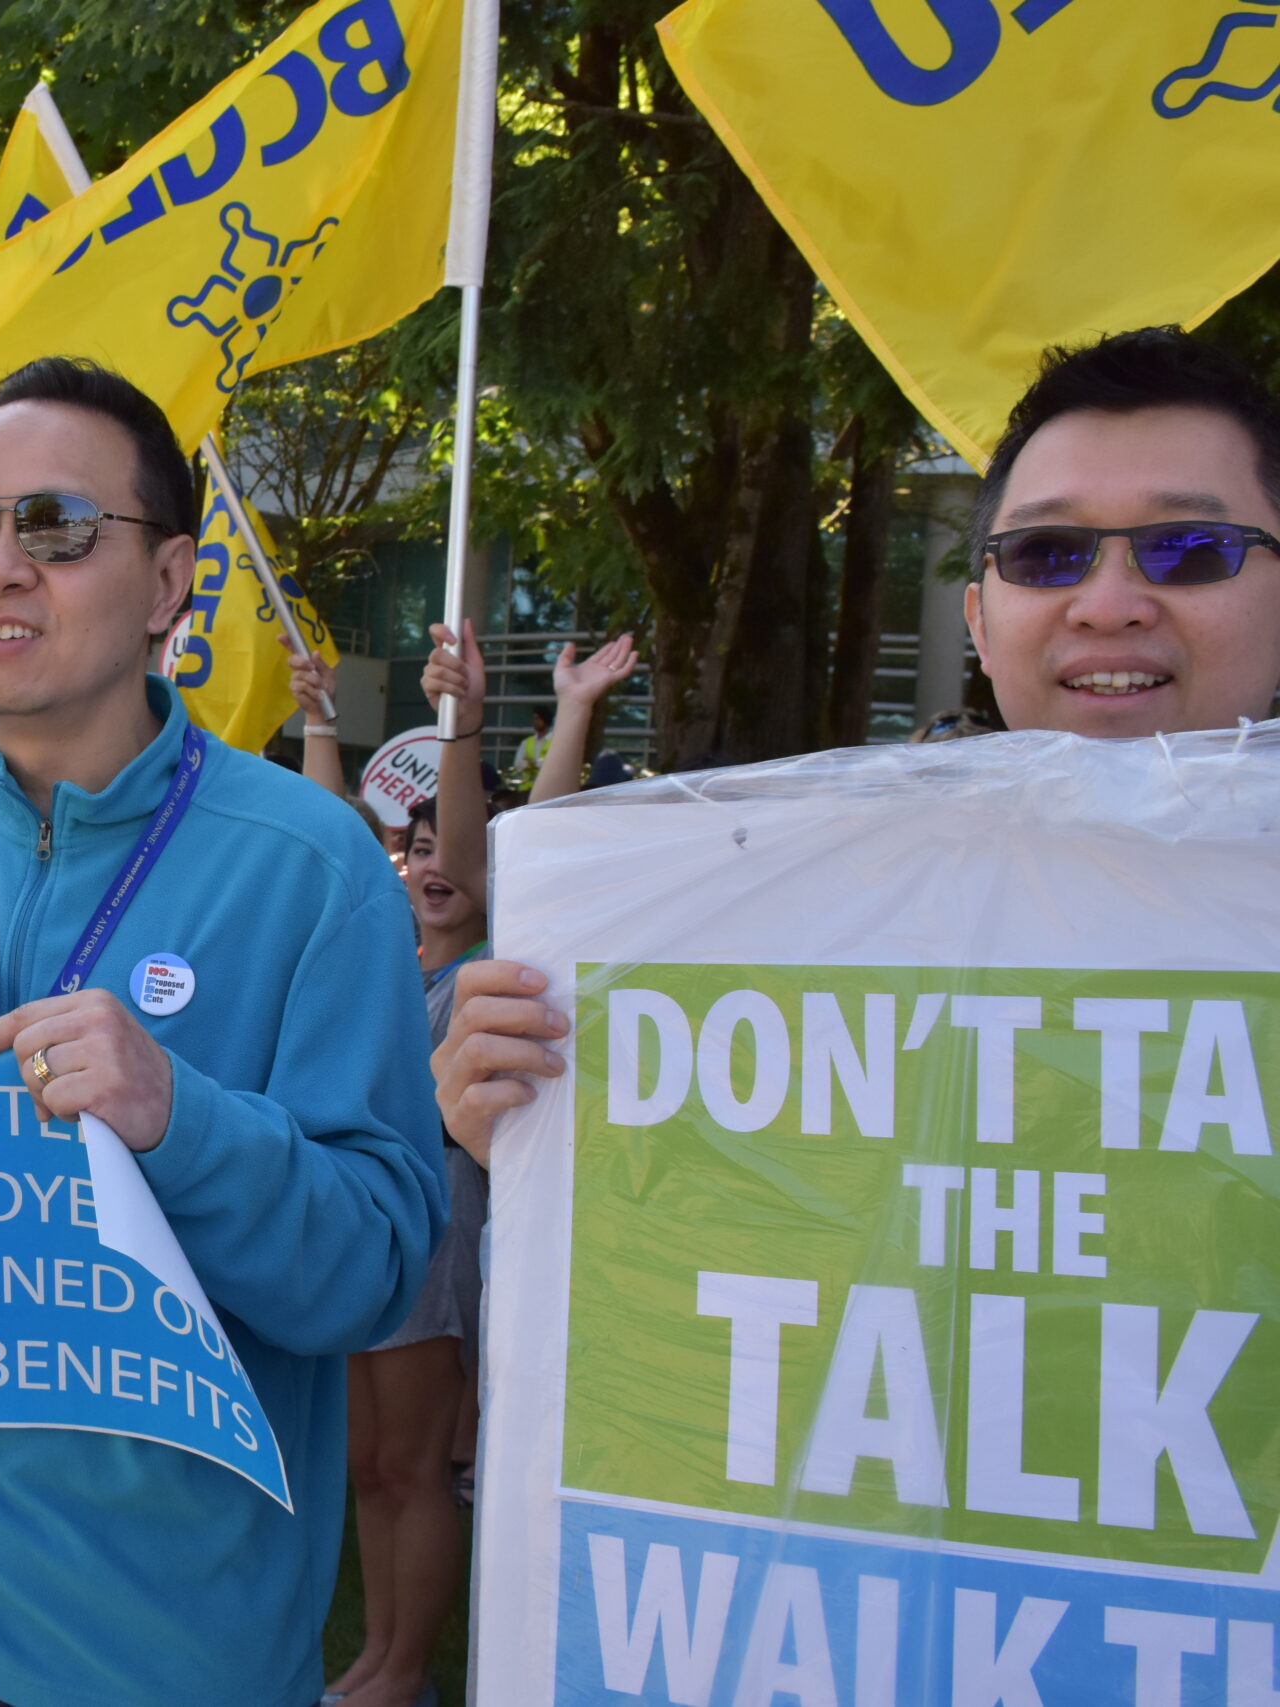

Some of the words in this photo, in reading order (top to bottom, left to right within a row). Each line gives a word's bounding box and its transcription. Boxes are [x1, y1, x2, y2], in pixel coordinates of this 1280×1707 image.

[94, 916, 109, 937] AIR
[76, 934, 100, 966] FORCE
[146, 977, 185, 989] Proposed
[148, 966, 169, 977] NO
[607, 989, 1042, 1144] DON'T
[902, 1163, 1107, 1279] THE
[696, 1271, 1261, 1540] TALK
